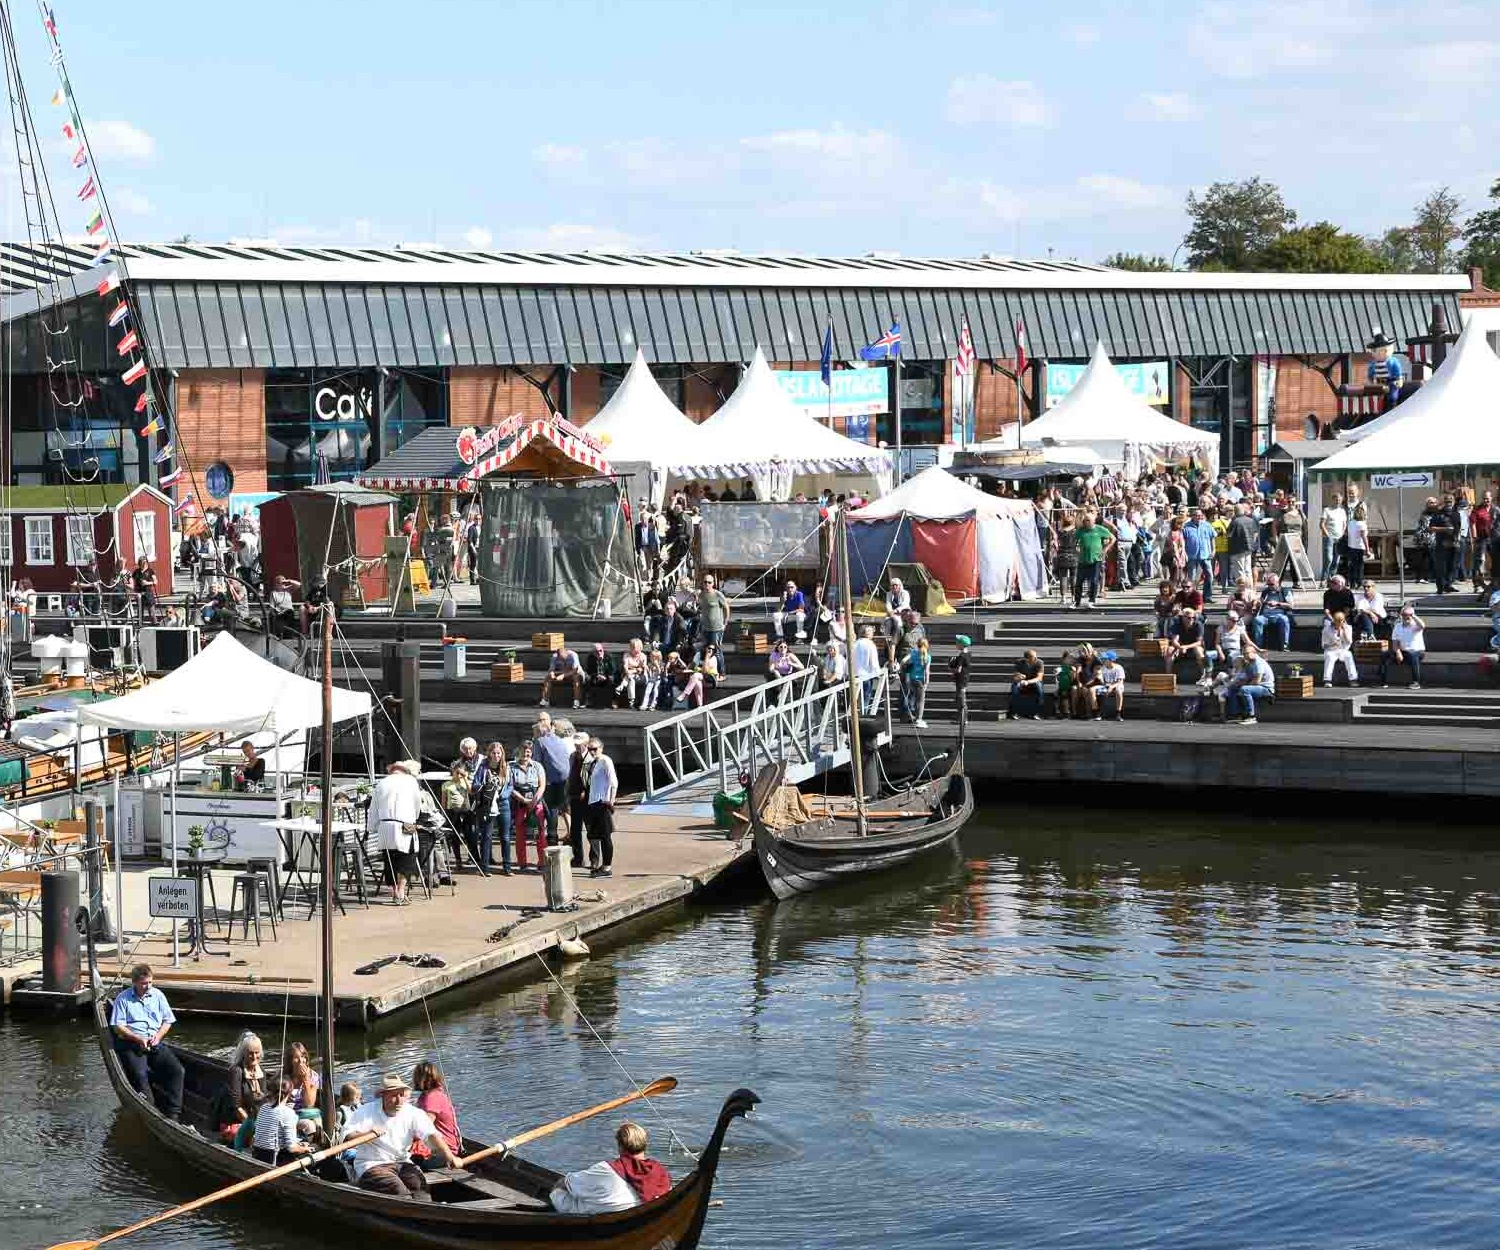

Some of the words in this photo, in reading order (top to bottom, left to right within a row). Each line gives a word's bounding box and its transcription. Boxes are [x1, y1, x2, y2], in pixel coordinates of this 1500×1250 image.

[1375, 477, 1393, 486] WC
[158, 885, 187, 897] Anlegen
[157, 899, 189, 910] verboten
